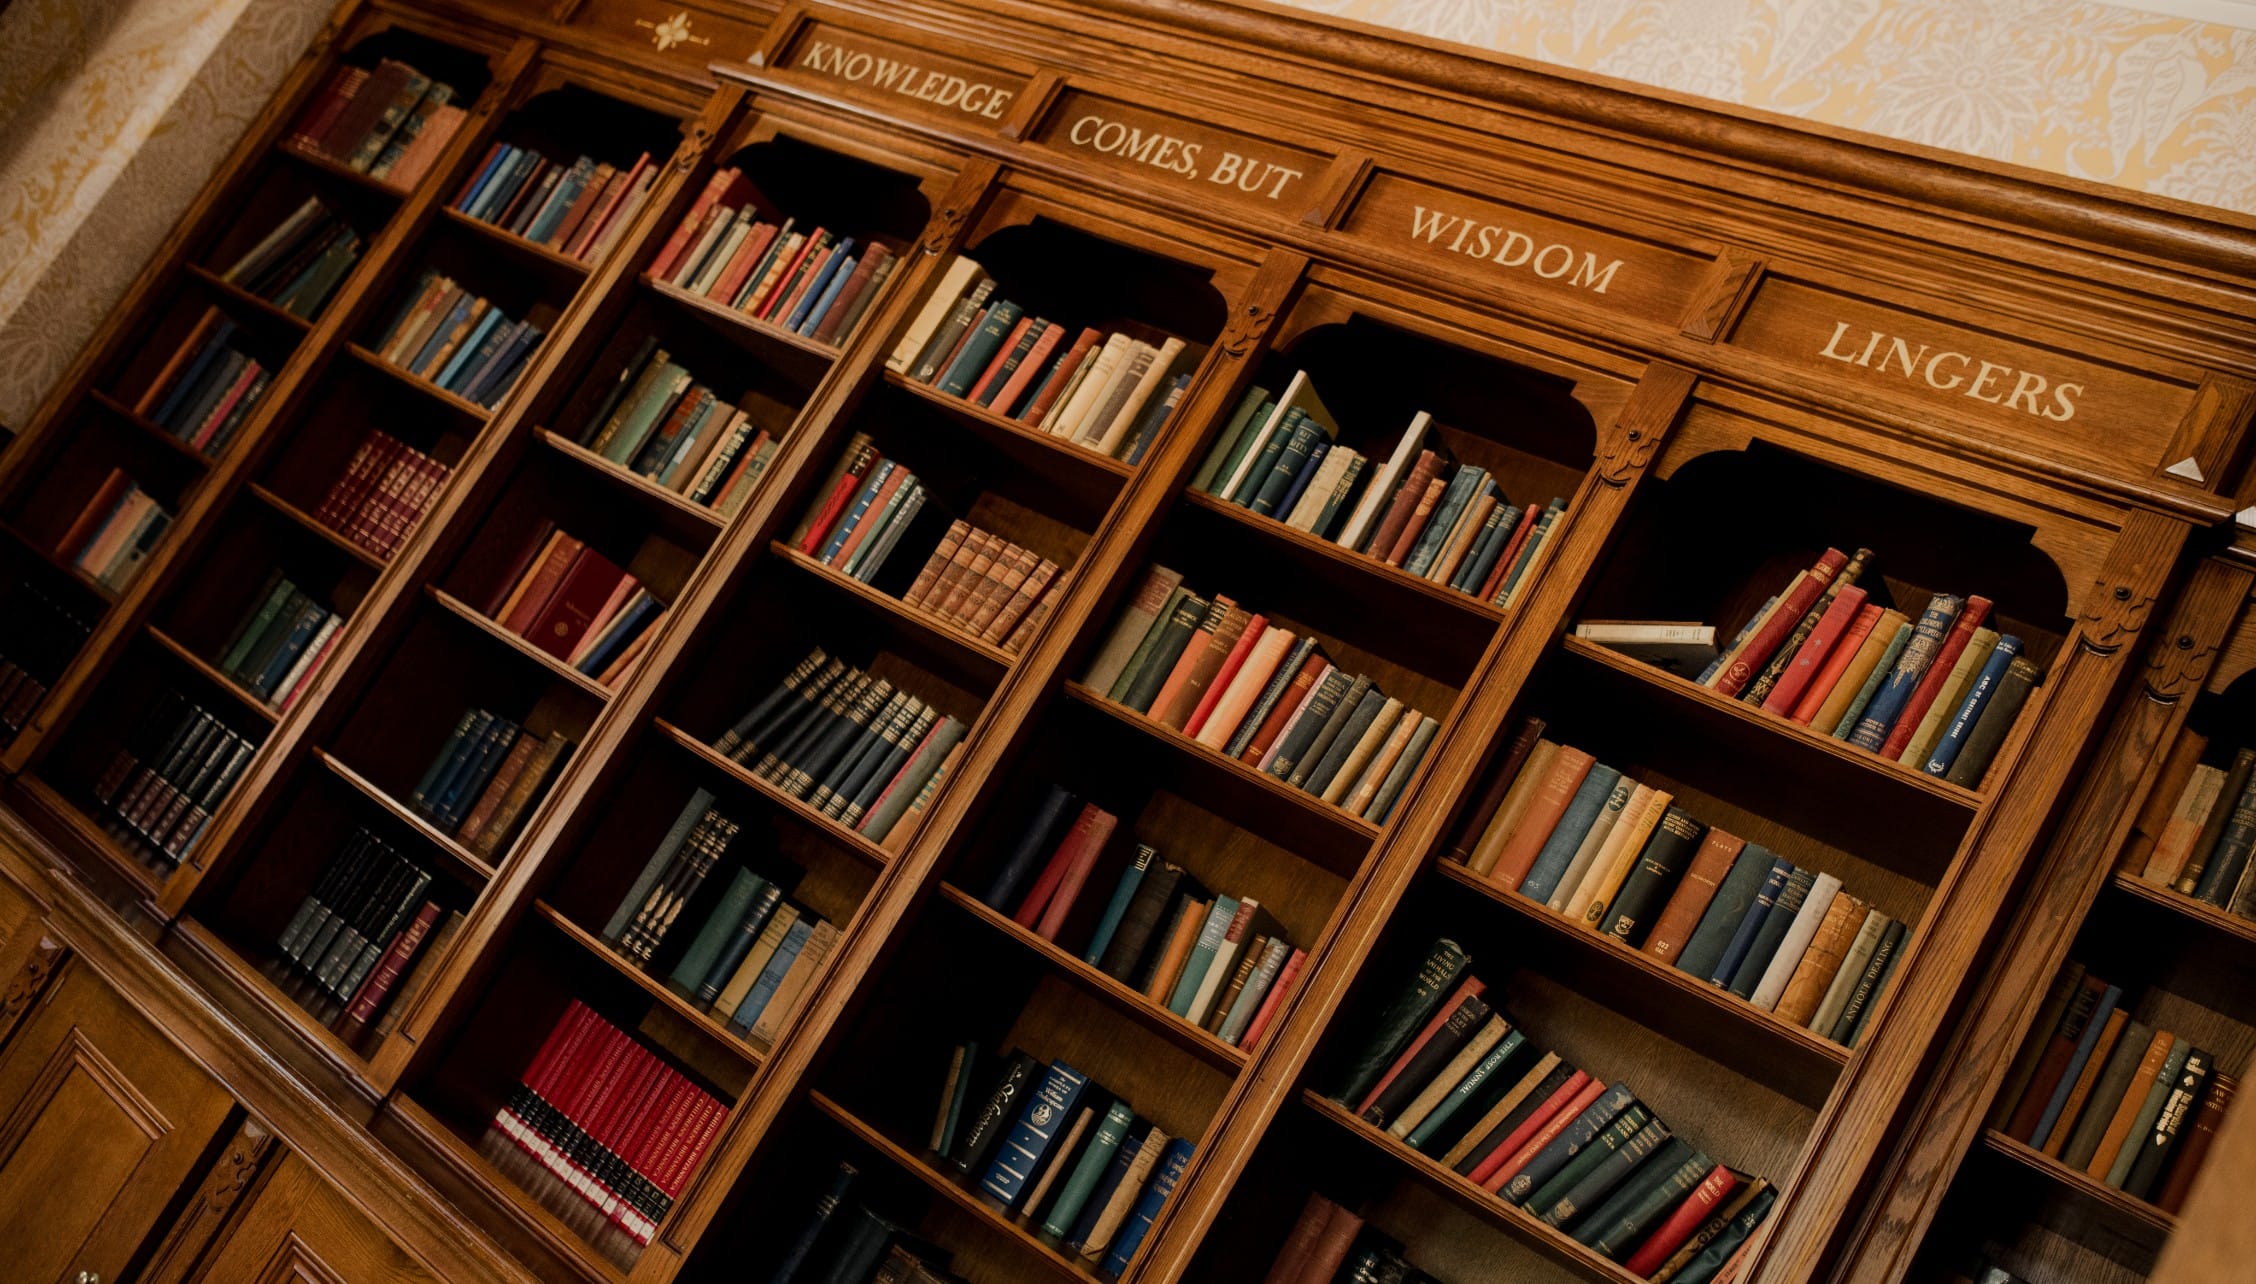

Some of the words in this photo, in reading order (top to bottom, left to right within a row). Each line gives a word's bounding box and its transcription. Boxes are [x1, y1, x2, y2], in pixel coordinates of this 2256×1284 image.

[802, 40, 1012, 121] KNOWLEDGE
[1069, 115, 1203, 178] COMES,
[1208, 154, 1303, 200] BUT
[1410, 206, 1624, 294] WISDOM
[1818, 322, 2084, 422] LINGERS
[1711, 840, 1732, 853] PLAYS
[1427, 959, 1451, 980] ANIMALS
[1433, 953, 1455, 970] LIVING
[1418, 972, 1440, 990] WORLD
[1846, 981, 1871, 1023] ANTIQUE
[1868, 941, 1893, 979] DEALING
[1500, 1041, 1514, 1054] THE
[1485, 1053, 1501, 1070] ROSE
[1459, 1070, 1485, 1094] ANNUAL
